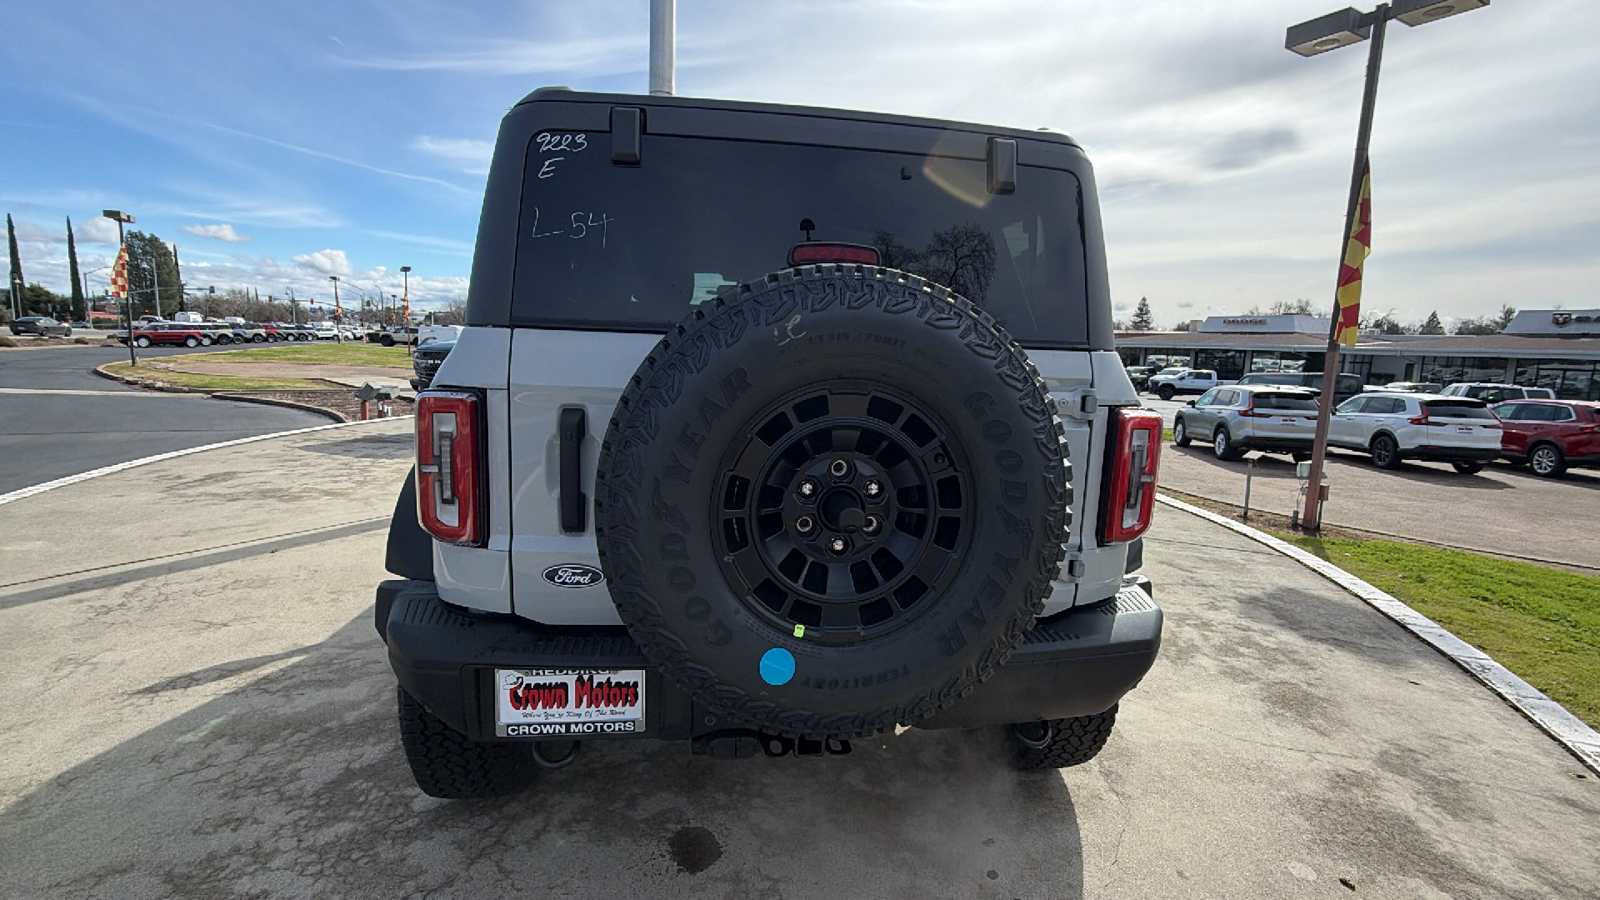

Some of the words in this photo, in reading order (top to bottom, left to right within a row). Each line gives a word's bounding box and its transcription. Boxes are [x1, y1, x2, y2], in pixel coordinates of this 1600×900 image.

[536, 132, 588, 154] 9223
[537, 157, 565, 179] E
[554, 567, 593, 583] Ford
[800, 663, 912, 690] TERRITORY
[509, 678, 569, 710] Crown
[574, 675, 639, 709] Motors
[521, 711, 542, 719] Where
[543, 711, 564, 720] You're
[566, 711, 582, 719] King
[584, 710, 593, 718] Of
[507, 724, 566, 735] CROWN
[570, 722, 634, 733] MOTORS
